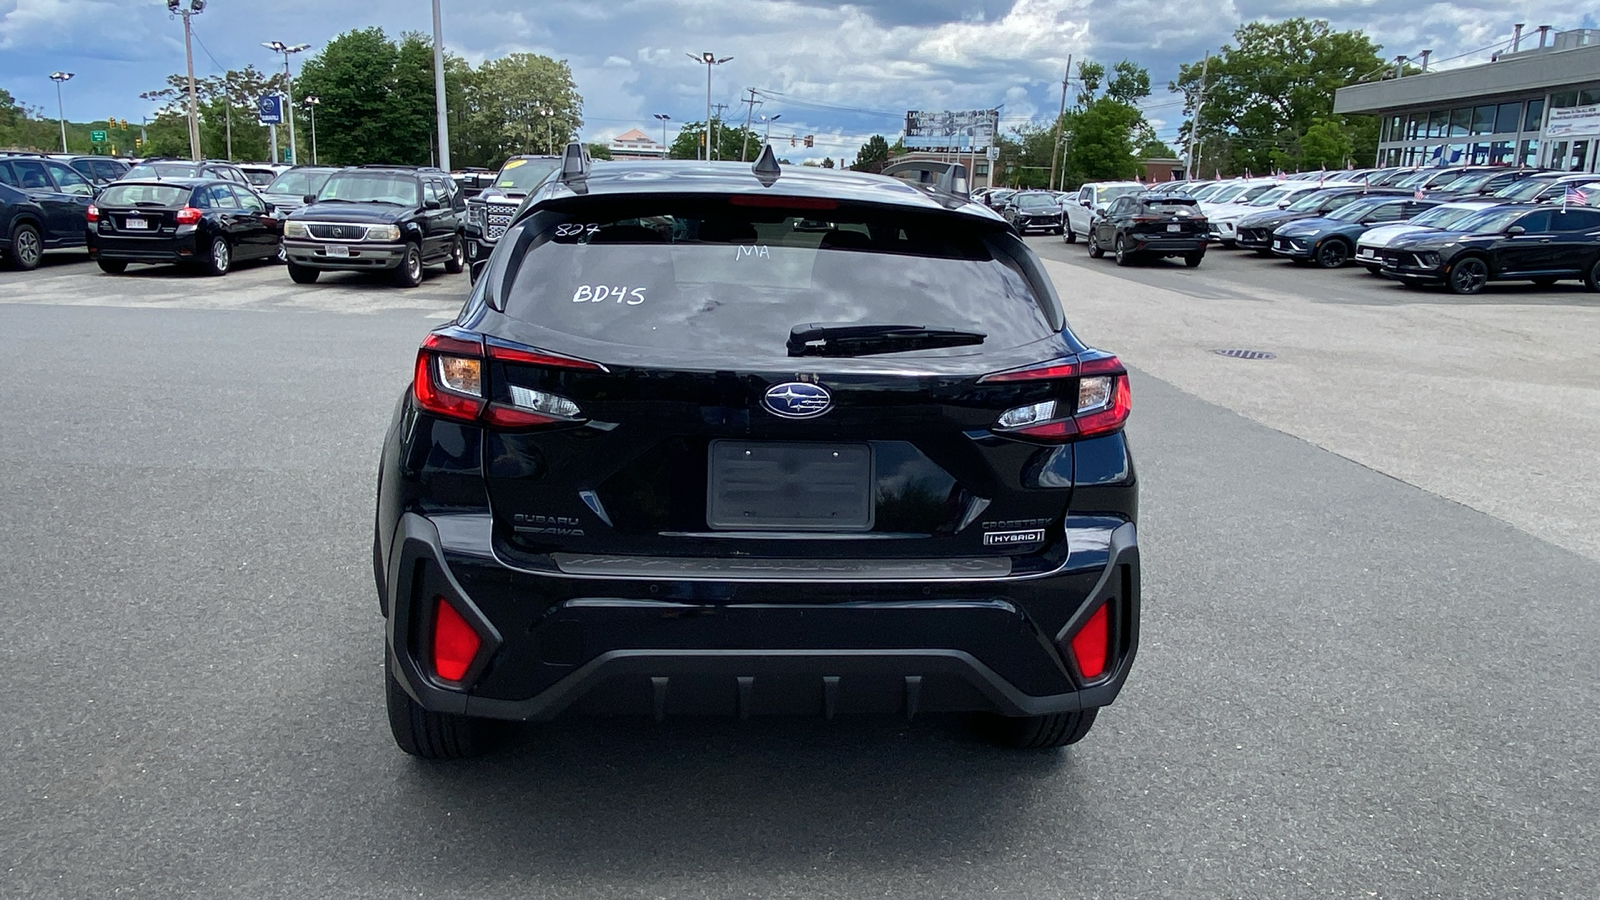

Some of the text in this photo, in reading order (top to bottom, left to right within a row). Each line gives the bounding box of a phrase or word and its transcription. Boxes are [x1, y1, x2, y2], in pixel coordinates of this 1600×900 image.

[735, 244, 770, 261] MA
[514, 513, 579, 525] SUBARU
[981, 517, 1053, 529] CROSSTREK
[541, 527, 585, 536] AWD
[994, 534, 1036, 542] HYBRID
